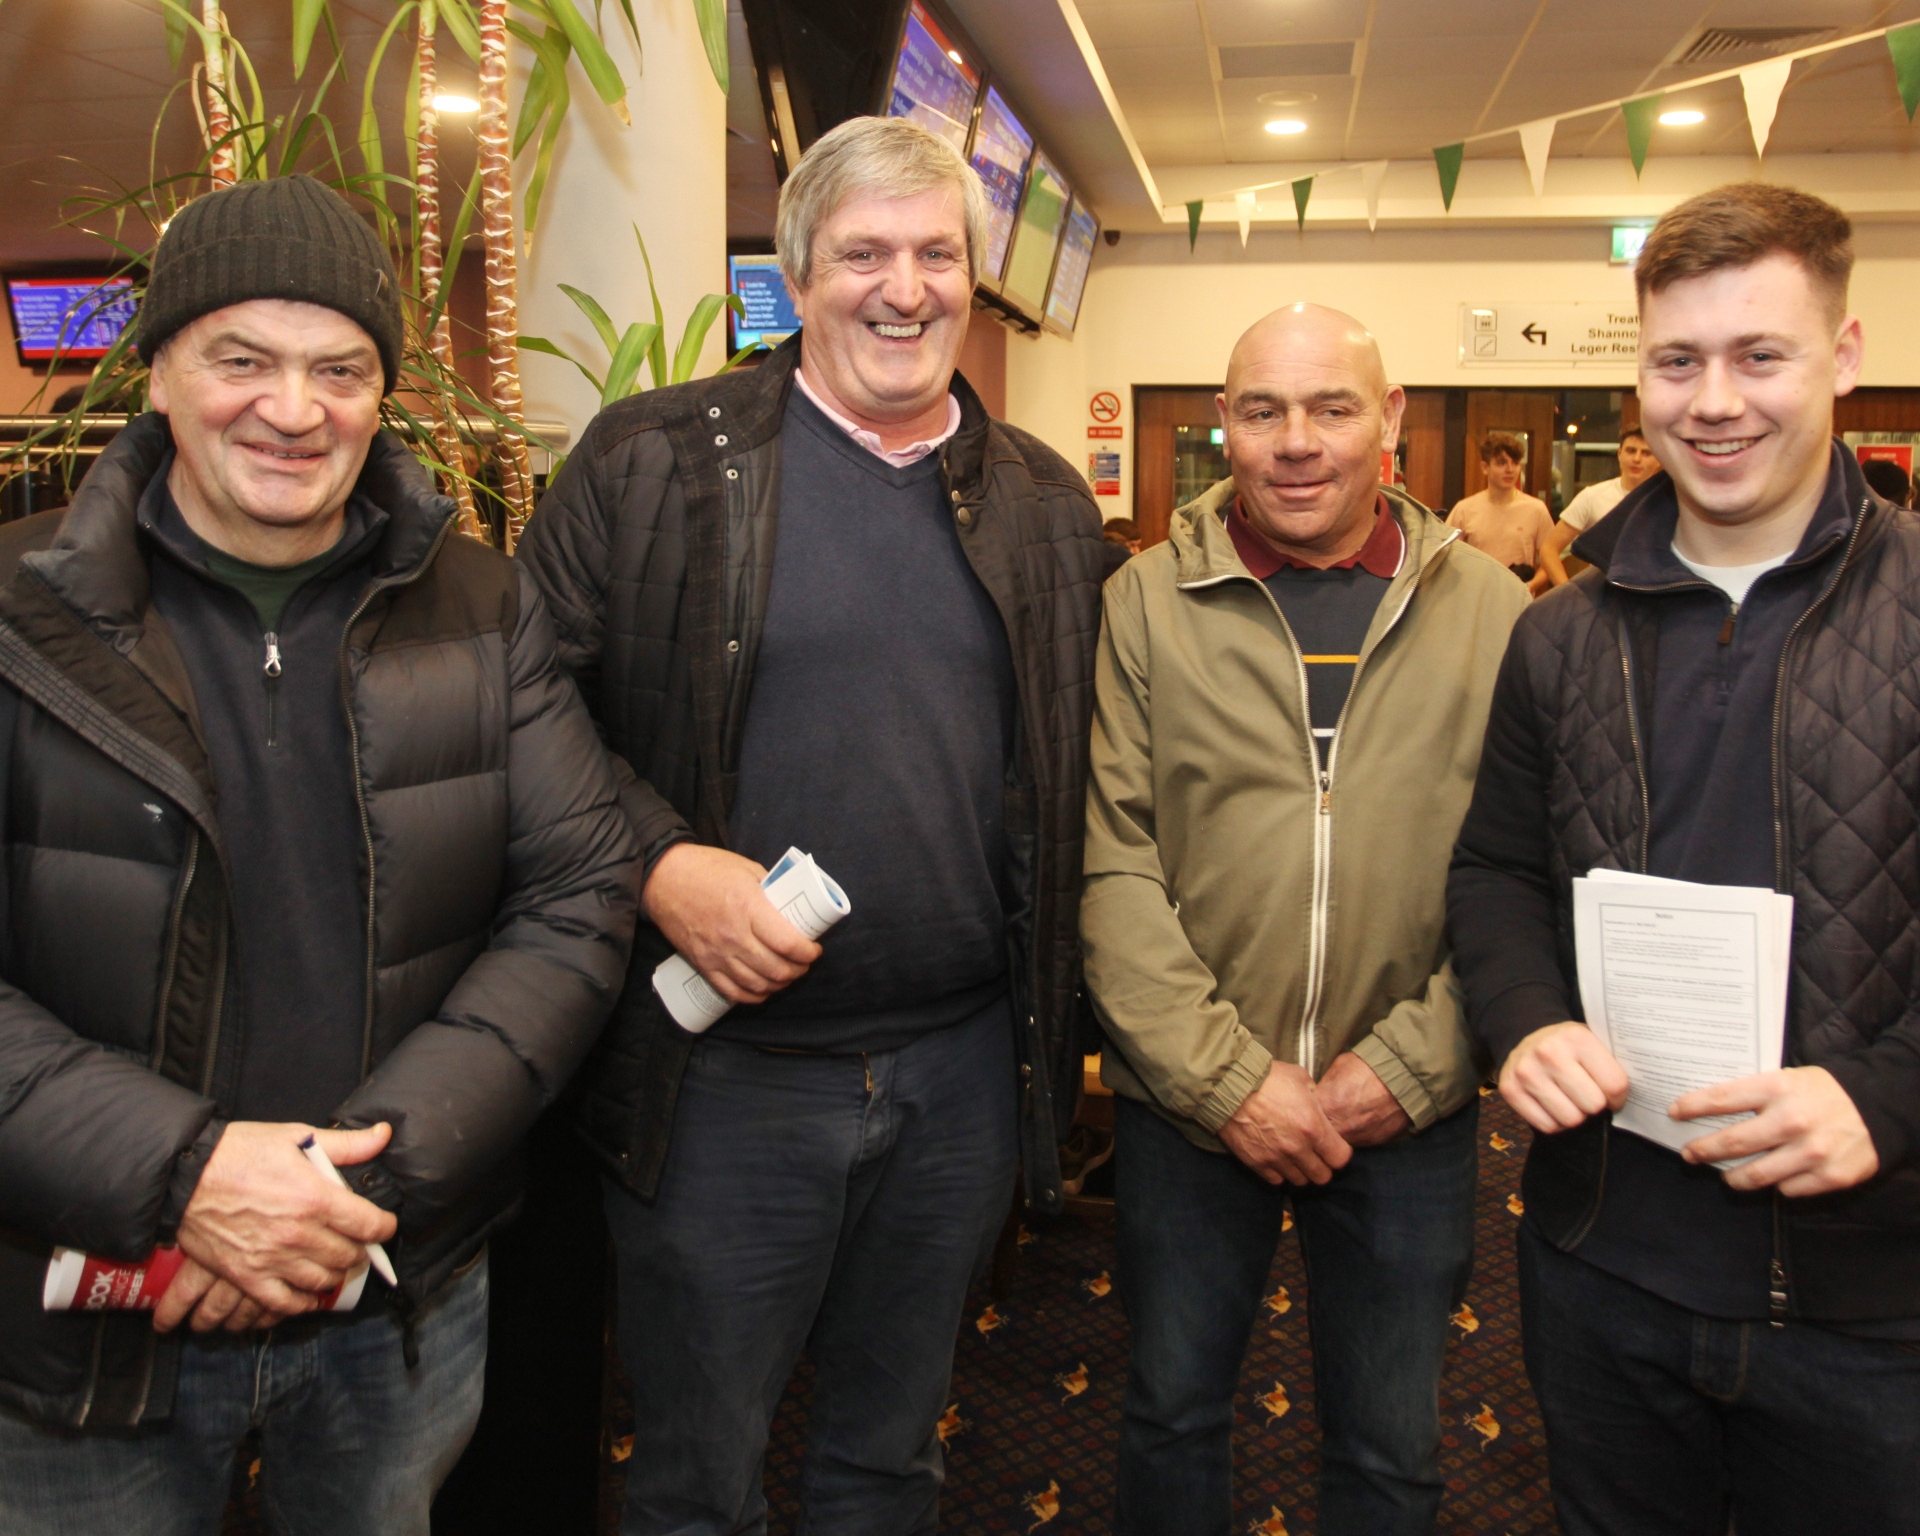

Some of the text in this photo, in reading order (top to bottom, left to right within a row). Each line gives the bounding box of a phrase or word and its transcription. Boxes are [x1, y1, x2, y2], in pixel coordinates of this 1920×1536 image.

[1607, 313, 1639, 324] Treat
[1588, 327, 1638, 339] Shanno
[1571, 342, 1637, 356] Leger Res
